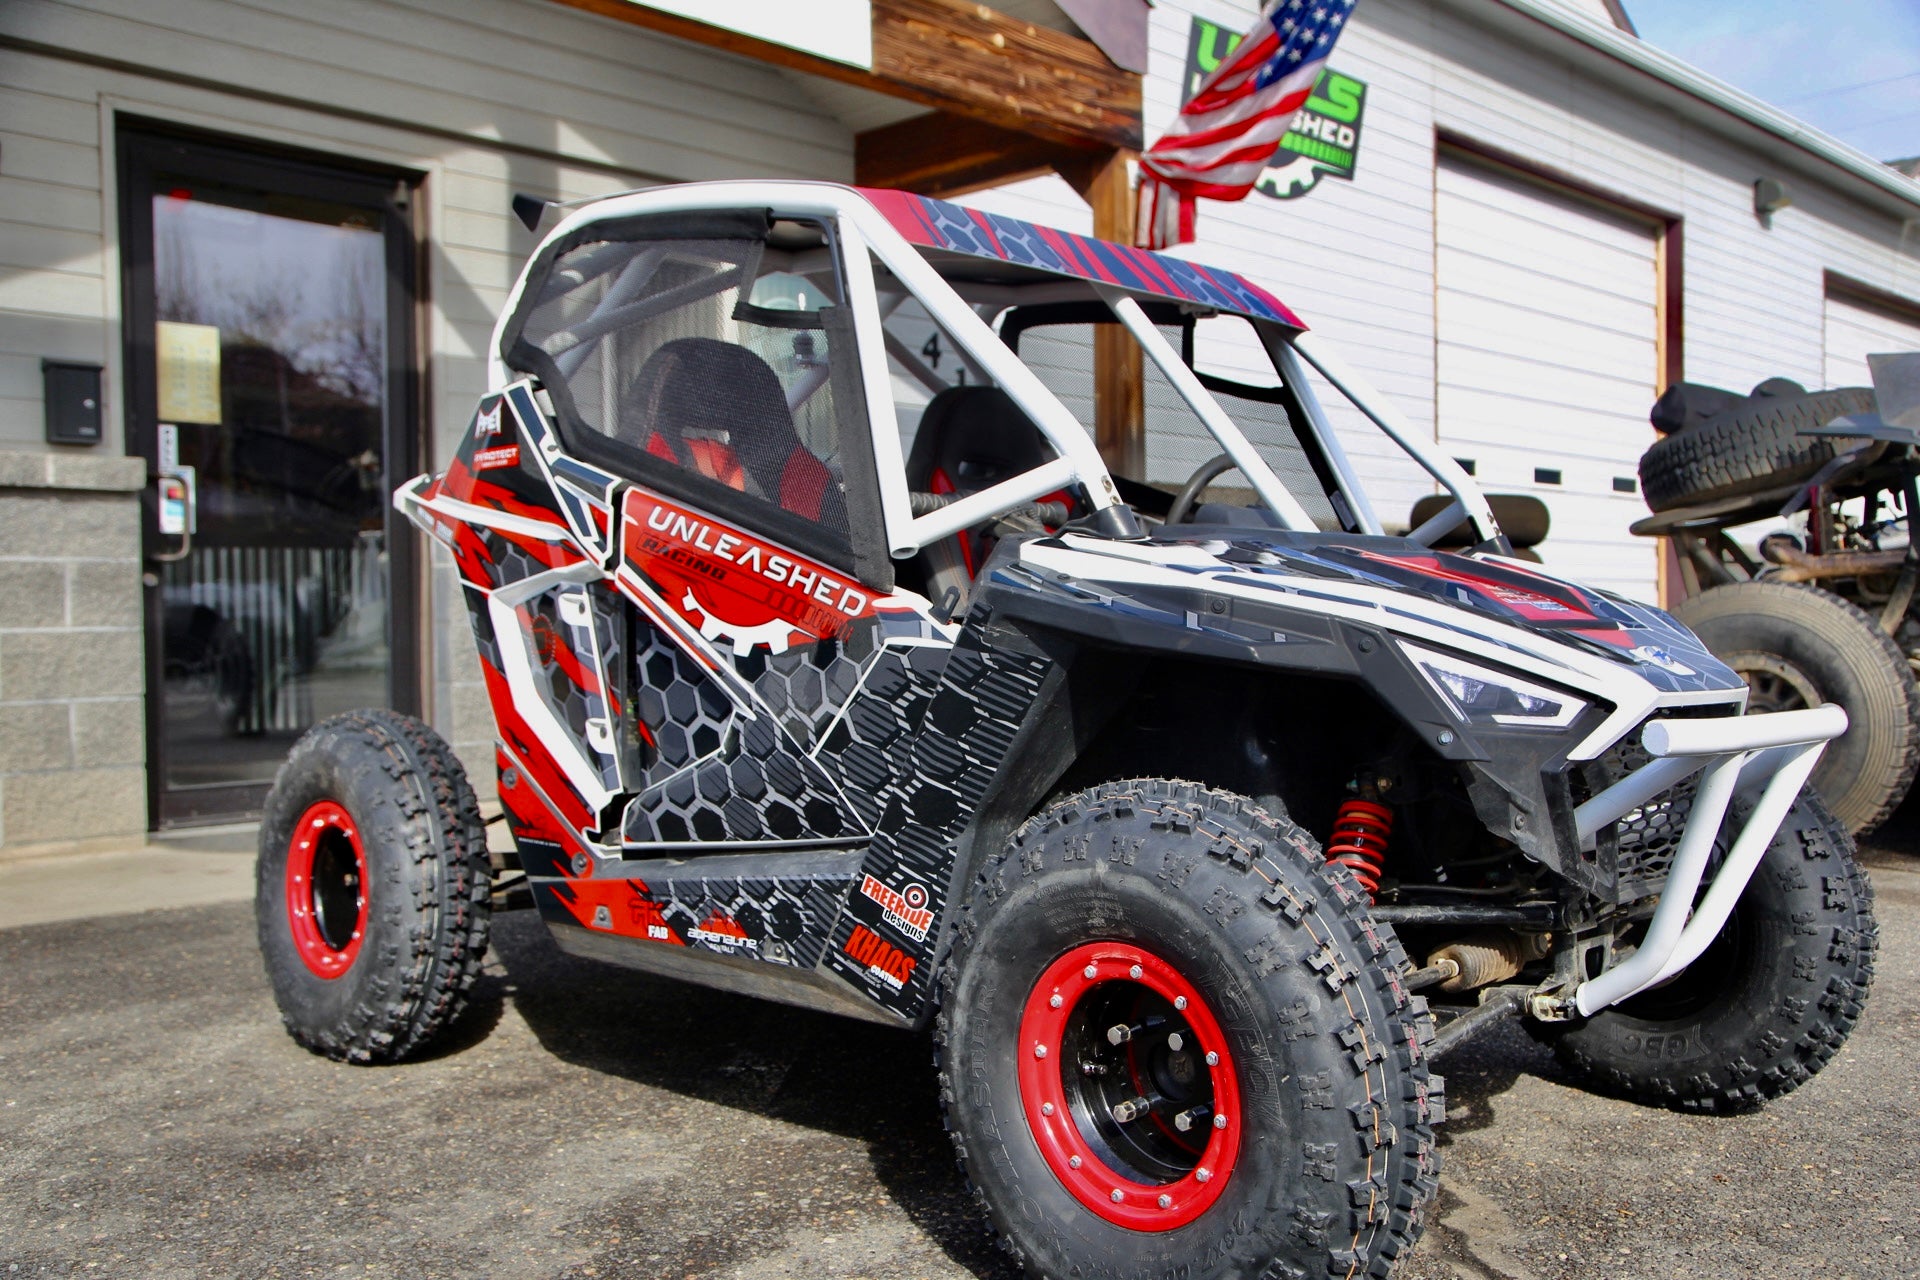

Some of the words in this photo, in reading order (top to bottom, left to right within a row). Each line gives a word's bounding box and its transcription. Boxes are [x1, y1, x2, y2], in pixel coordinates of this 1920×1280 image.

[647, 505, 868, 618] UNLEASHED
[648, 924, 669, 940] FAB
[883, 908, 924, 941] designs
[843, 924, 918, 985] KHAOS
